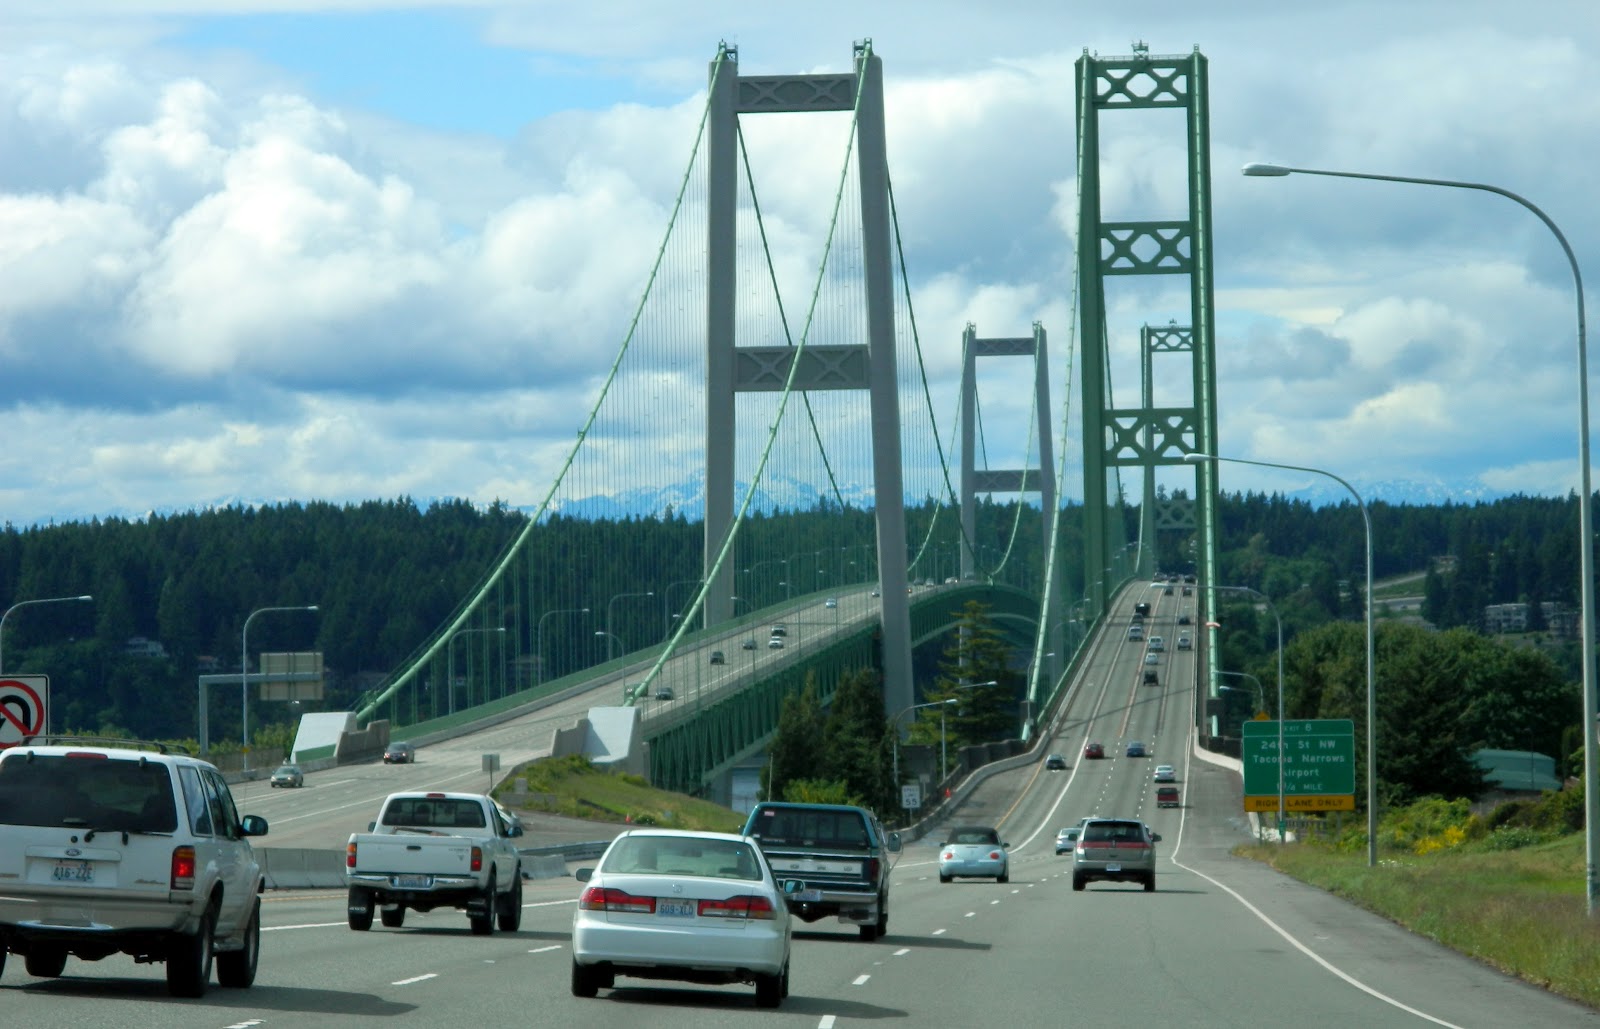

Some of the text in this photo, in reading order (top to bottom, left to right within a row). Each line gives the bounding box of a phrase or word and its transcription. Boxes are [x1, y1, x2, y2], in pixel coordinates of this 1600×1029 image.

[1298, 741, 1310, 749] St
[1319, 740, 1336, 749] NW
[1302, 754, 1345, 763] Narrows
[1303, 783, 1323, 791] MILE
[905, 798, 918, 806] 55
[1317, 799, 1344, 807] ONLY
